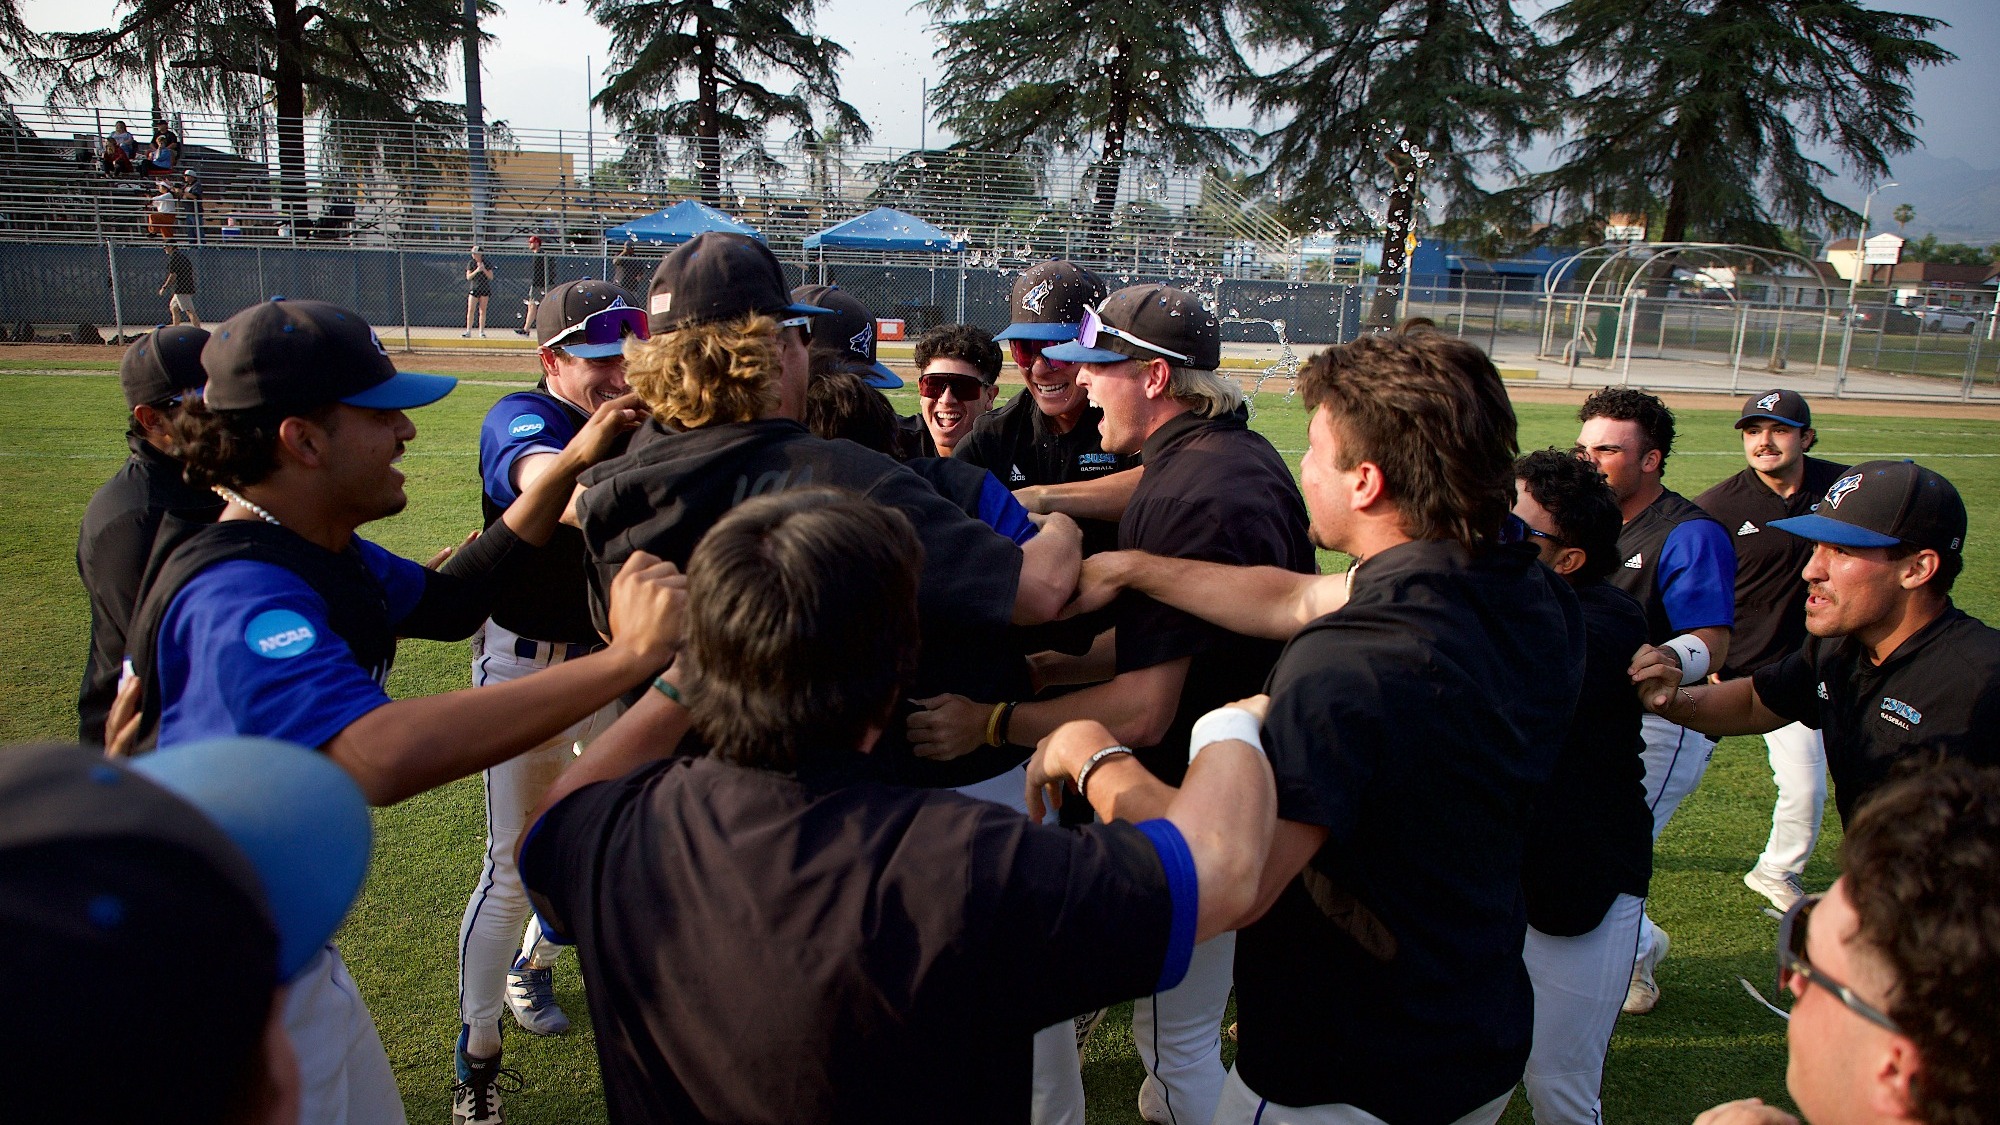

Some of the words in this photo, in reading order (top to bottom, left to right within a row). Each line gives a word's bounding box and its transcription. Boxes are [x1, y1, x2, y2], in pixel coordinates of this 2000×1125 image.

[512, 423, 542, 434] NCAA
[258, 626, 314, 653] NCAA
[1880, 697, 1922, 725] CSUSB
[1880, 712, 1910, 731] BASEBALL
